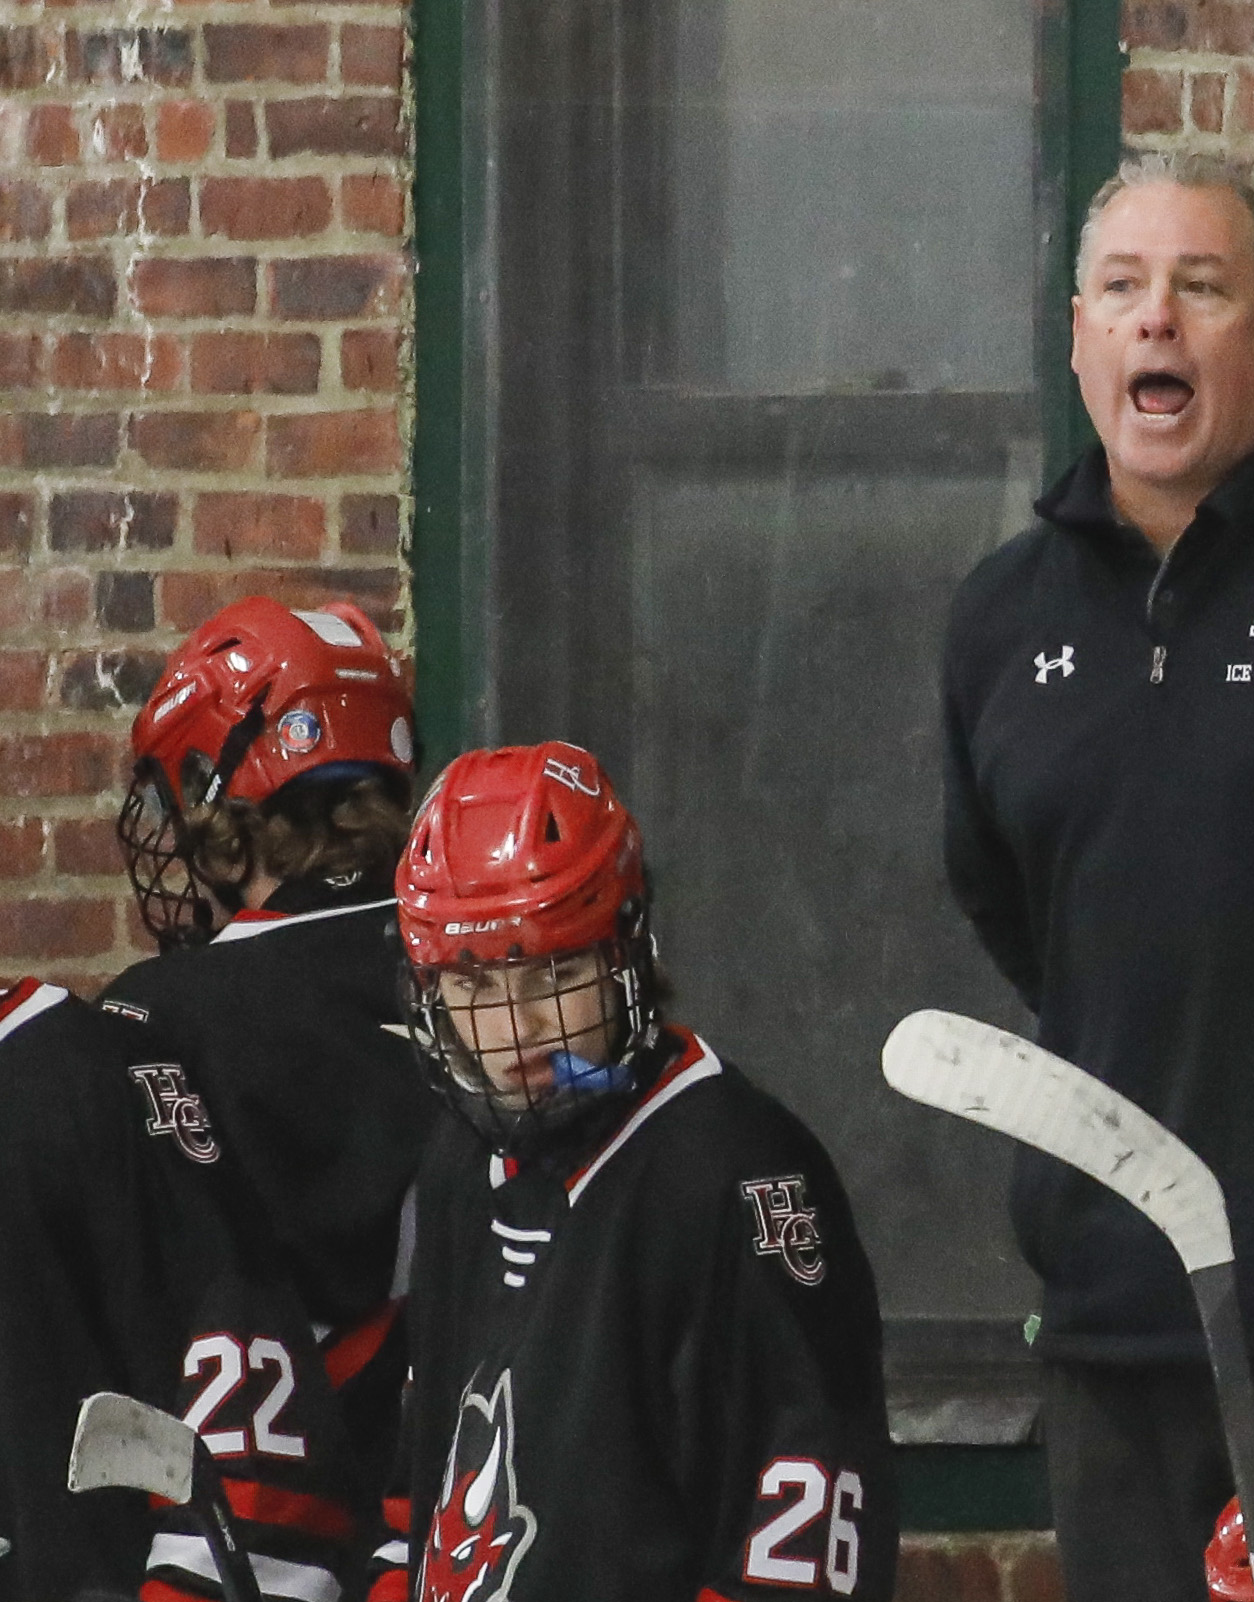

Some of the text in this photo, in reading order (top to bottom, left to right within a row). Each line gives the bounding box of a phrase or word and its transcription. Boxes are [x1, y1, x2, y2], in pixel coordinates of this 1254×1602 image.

[1225, 663, 1252, 682] ICE
[445, 917, 521, 936] BAU
[128, 1063, 221, 1164] HC
[741, 1174, 826, 1286] HC
[181, 1333, 308, 1458] 22
[745, 1459, 863, 1596] 26
